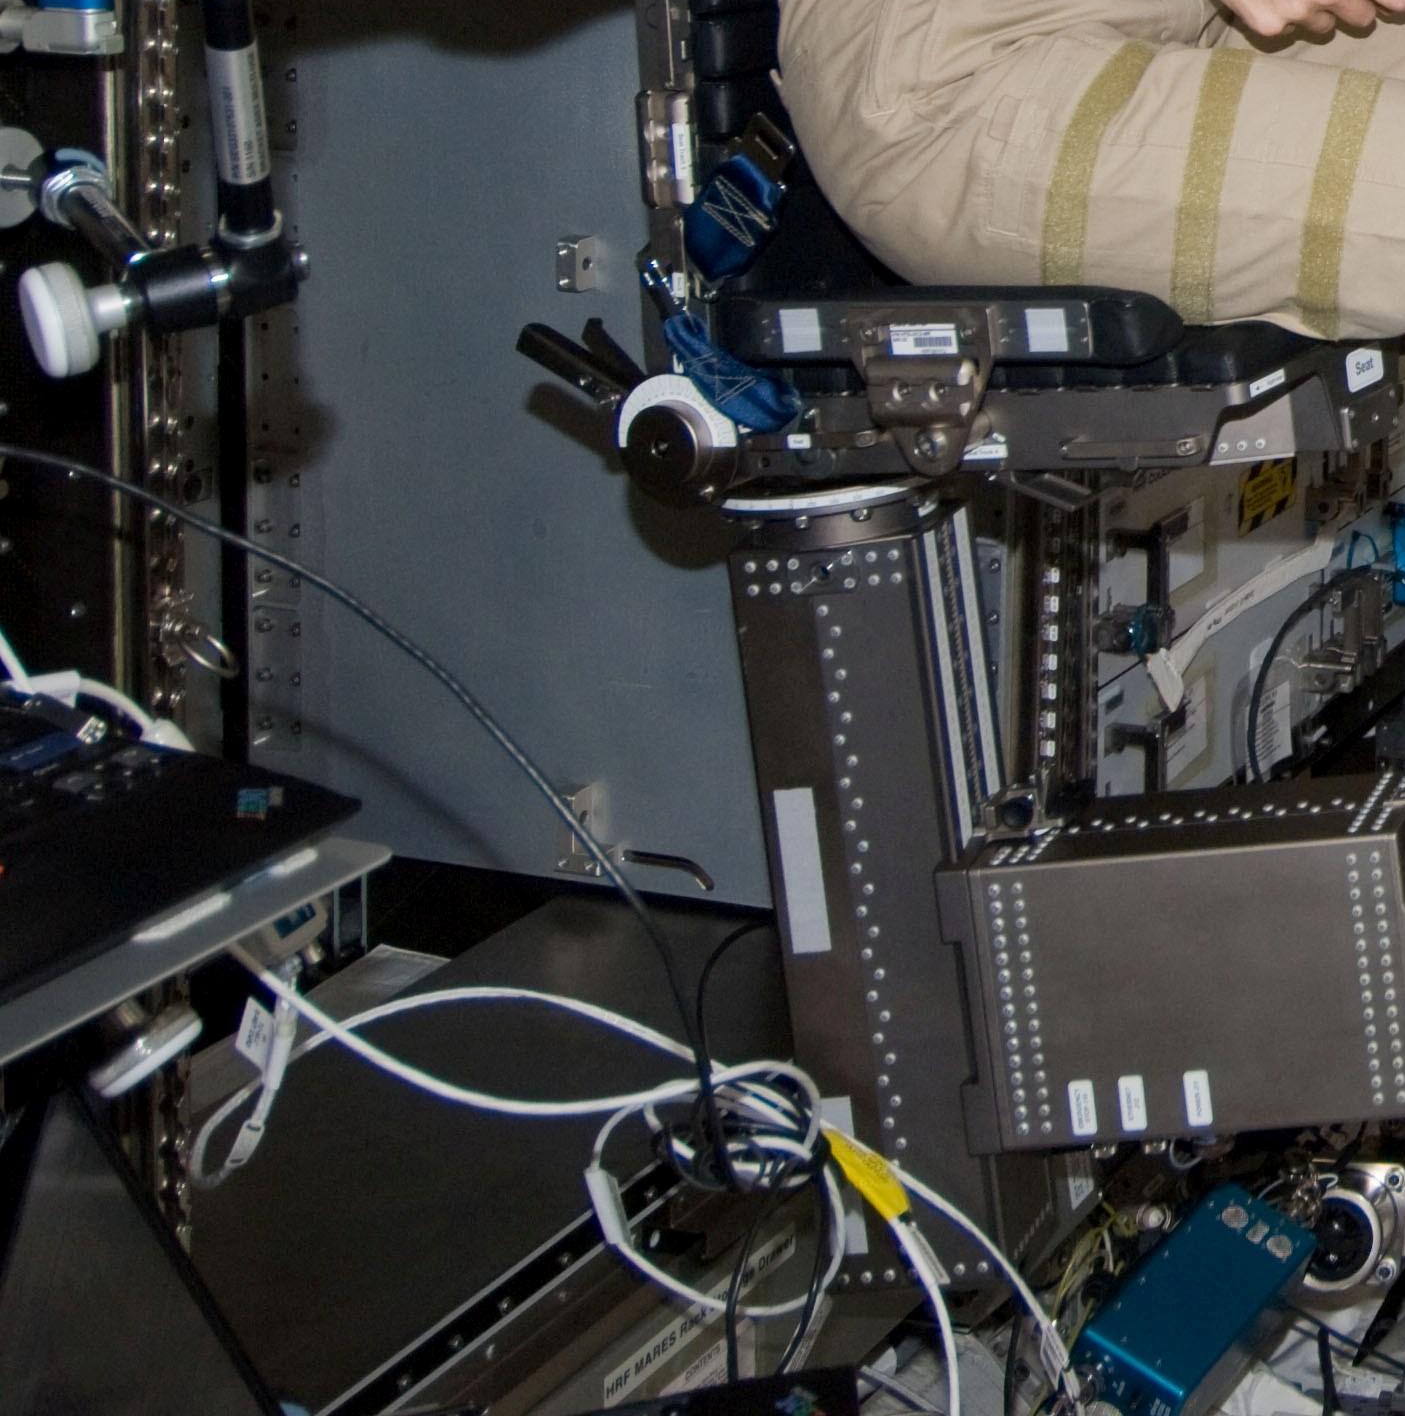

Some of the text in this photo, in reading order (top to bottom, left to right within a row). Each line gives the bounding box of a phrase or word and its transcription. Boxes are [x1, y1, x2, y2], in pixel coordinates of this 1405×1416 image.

[1354, 357, 1374, 376] Seat
[606, 1368, 634, 1401] HRF
[633, 1324, 679, 1371] MARES
[678, 1305, 708, 1332] Rack
[755, 1235, 797, 1272] Drawer
